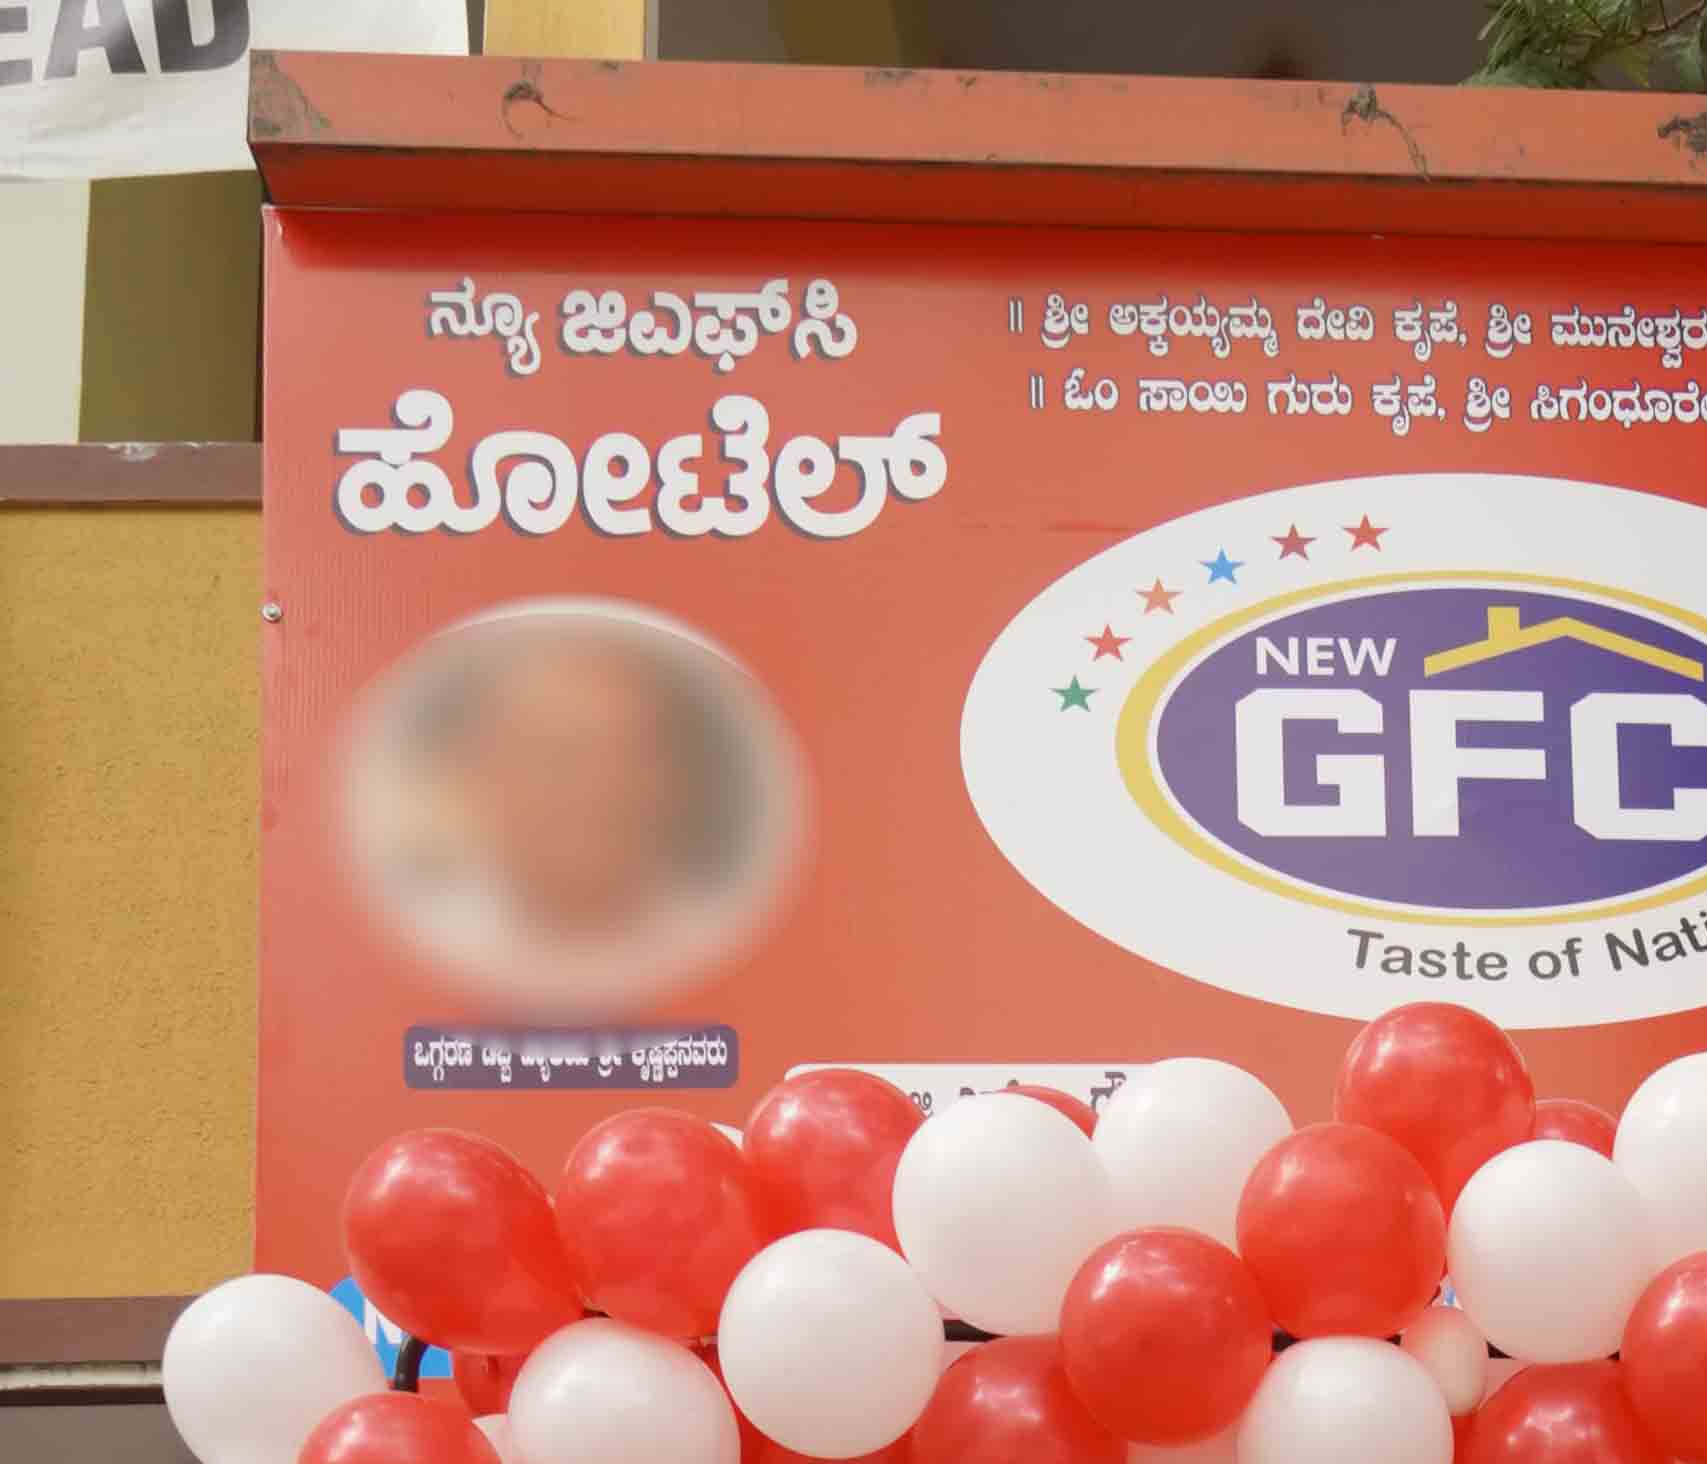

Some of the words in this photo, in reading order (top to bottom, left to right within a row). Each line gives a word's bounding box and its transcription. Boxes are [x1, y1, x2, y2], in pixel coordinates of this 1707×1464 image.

[432, 277, 541, 375] ನ್ಯೂ
[1042, 293, 1088, 348] ಶ್ರೀ
[1109, 296, 1280, 359] ಅಕ್ಕಯ್ಯಮ್ಮ
[1297, 297, 1375, 340] ದೇವಿ
[1486, 303, 1532, 359] ಶ್ರೀ
[1064, 368, 1119, 411] ಓಂ
[1139, 377, 1247, 413] ಸಾಯಿ
[1267, 373, 1352, 415] ಗುರು
[1464, 377, 1510, 432] ಶ್ರೀ
[338, 389, 948, 538] ಹೋಟೆಲ್
[1254, 635, 1397, 678] NEW
[1347, 928, 1509, 982] Taste
[1528, 938, 1583, 980] of
